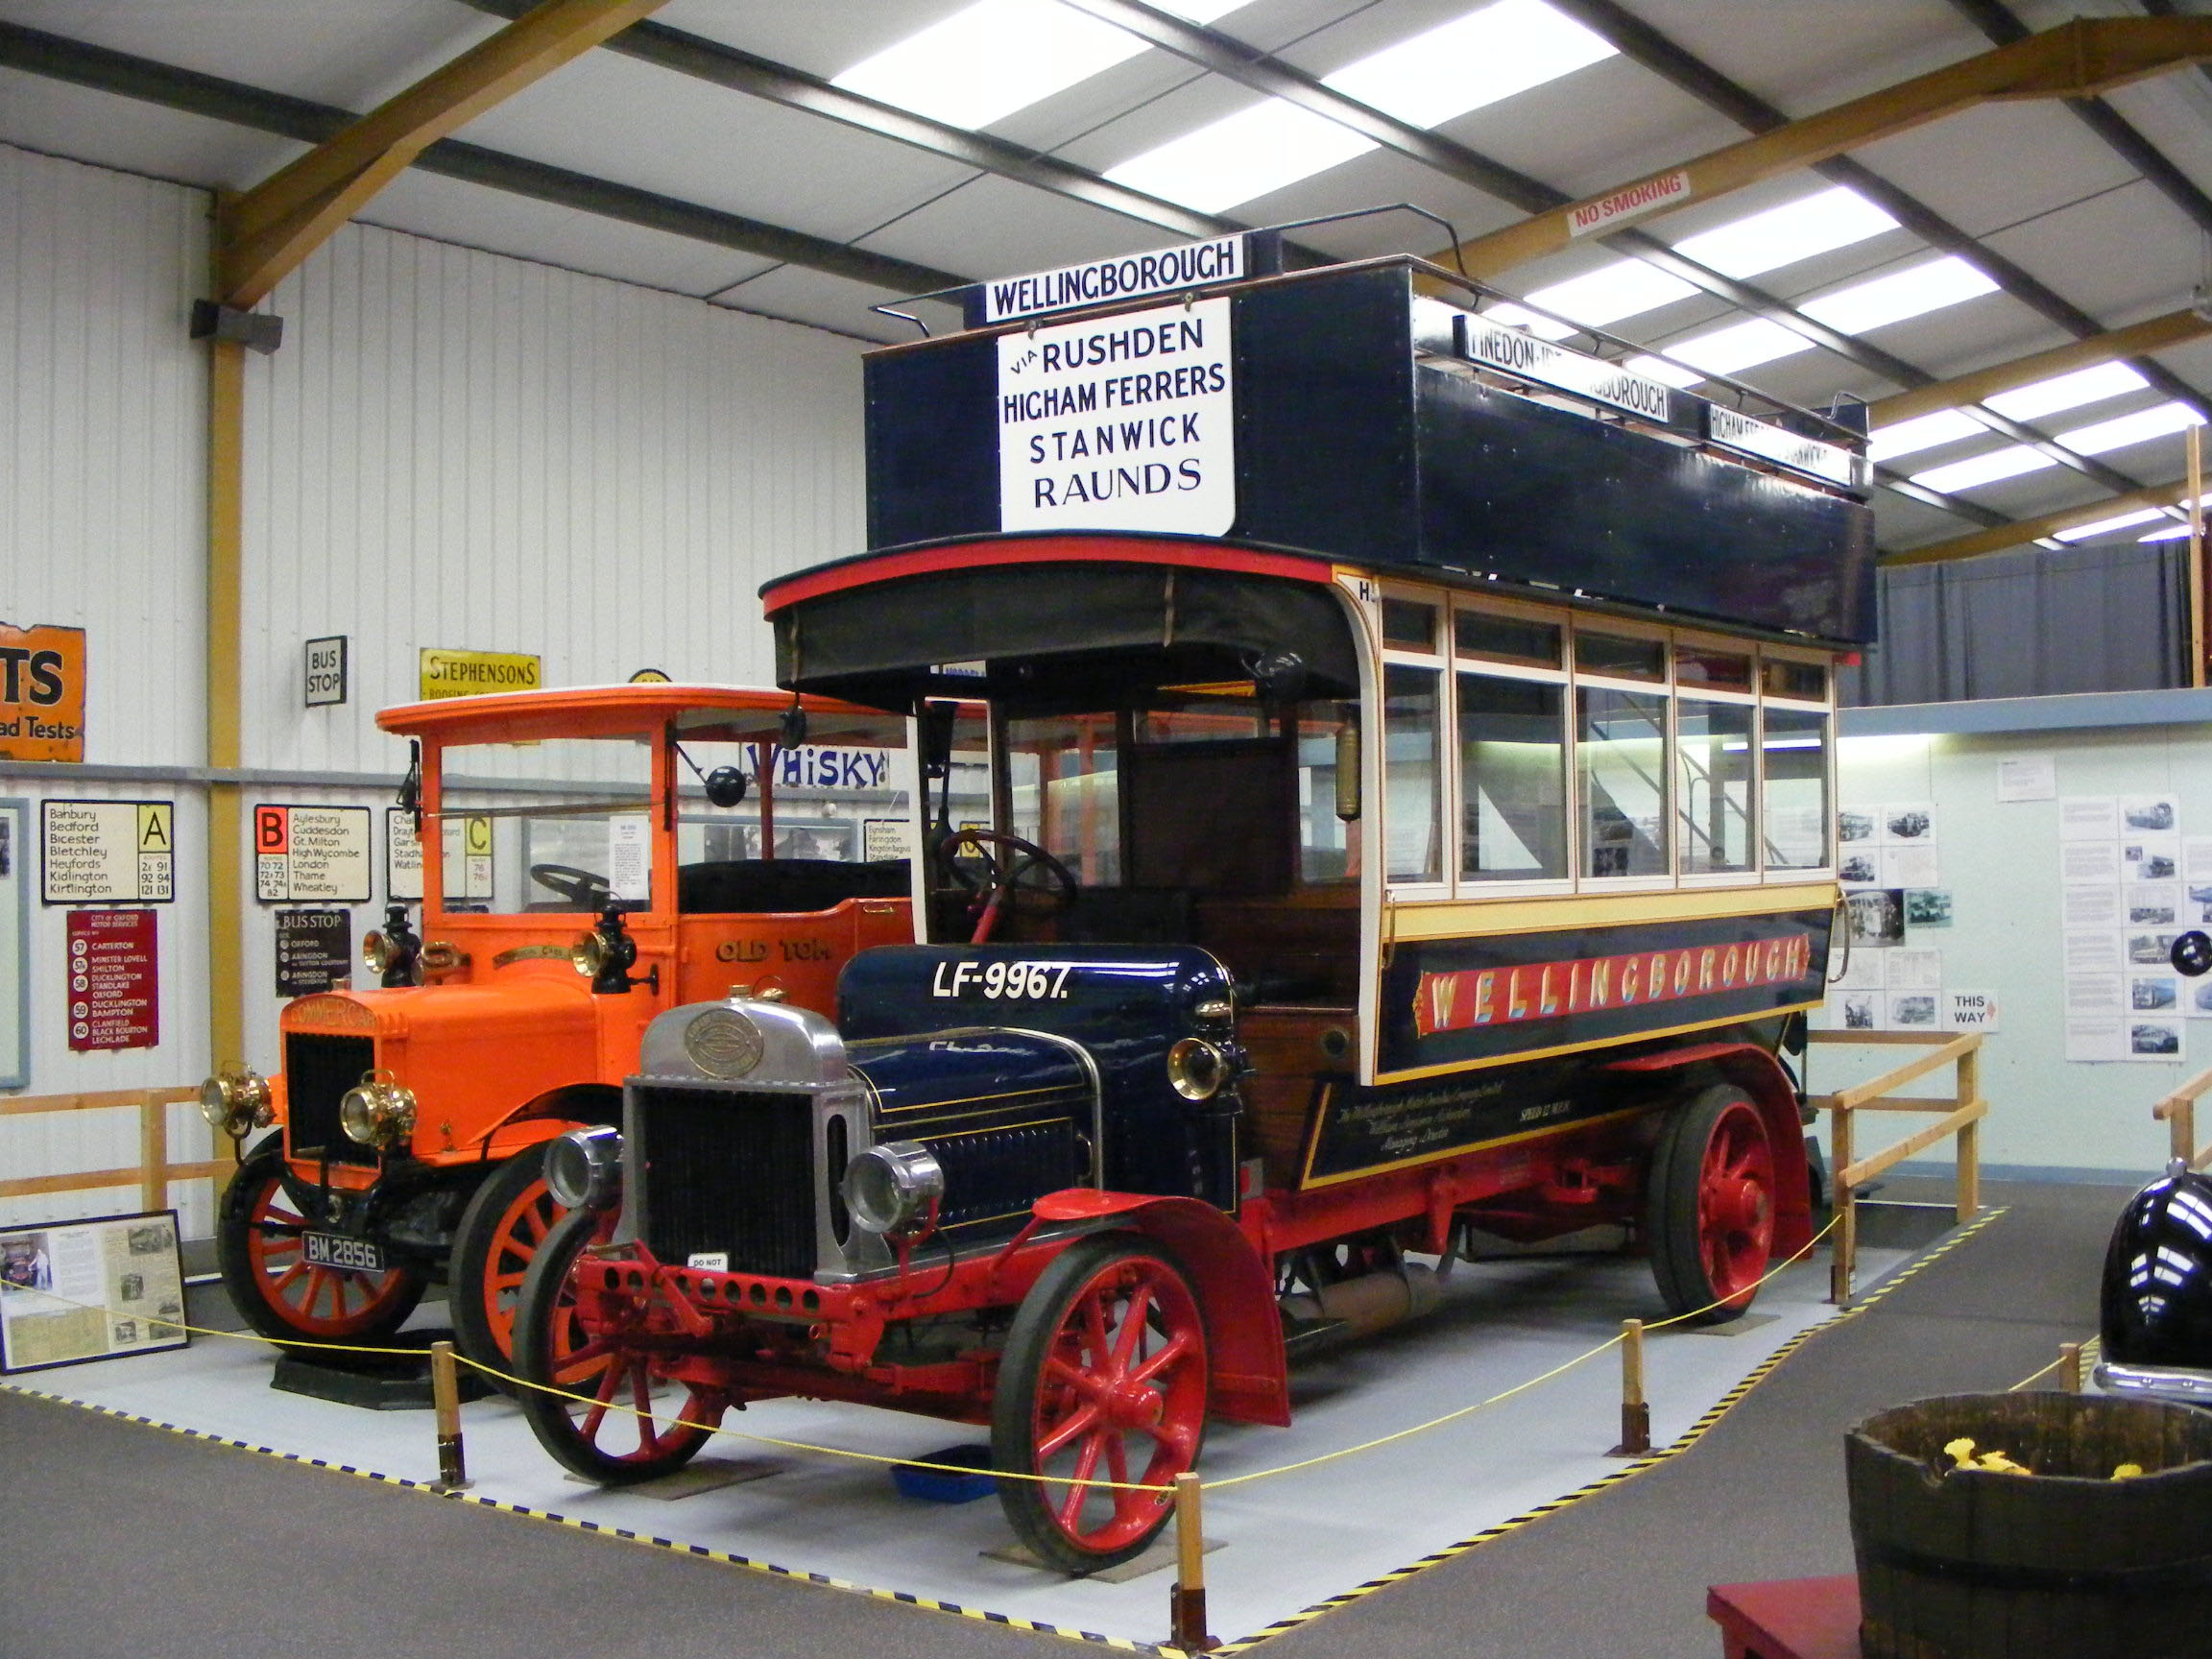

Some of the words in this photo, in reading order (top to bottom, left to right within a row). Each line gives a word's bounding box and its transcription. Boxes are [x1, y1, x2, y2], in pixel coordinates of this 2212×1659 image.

[1575, 204, 1599, 228] NO
[1602, 175, 1682, 217] SMOKING
[994, 240, 1235, 317] WELLINGBOROUGH
[1010, 349, 1038, 374] VIA
[1043, 319, 1203, 373] RUSHDEN
[1003, 382, 1097, 423] HIGHAM
[1105, 362, 1226, 408] FERRERS
[1029, 412, 1200, 464] STANWICK
[1034, 458, 1201, 508] RAUNDS
[1359, 581, 1369, 602] H
[312, 650, 336, 669] BUS
[0, 646, 63, 706] TS
[429, 656, 536, 685] STEPHENSONS
[308, 673, 341, 692] STOP
[0, 716, 20, 737] ad
[25, 716, 74, 739] Tests
[50, 808, 96, 822] Banbury
[293, 814, 340, 827] Aylesbury
[50, 821, 99, 831] Bedford
[143, 811, 166, 845] A
[261, 812, 283, 847] B
[293, 826, 349, 835] Cuddesdon
[50, 833, 100, 844] Bicester
[469, 817, 487, 850] C
[308, 837, 340, 846] Milton
[869, 835, 902, 845] Faringdon
[50, 847, 107, 859] Bletchley
[293, 849, 313, 859] High
[314, 849, 360, 860] Wycombe
[50, 859, 101, 872] Heyfords
[157, 861, 167, 871] 91
[260, 861, 271, 870] 70
[272, 861, 283, 870] 72
[293, 860, 329, 869] London
[50, 871, 108, 883] Kidlington
[141, 873, 153, 882] 92
[157, 873, 169, 882] 94
[294, 871, 325, 880] Thame
[50, 884, 112, 897] Kirtlington
[141, 885, 153, 895] 121
[157, 885, 168, 895] 131
[294, 883, 337, 895] Wheatley
[283, 916, 308, 929] BUS
[309, 915, 341, 928] STOP
[75, 943, 84, 951] 57
[91, 942, 134, 950] CARTERTON
[92, 965, 125, 974] SHILTON
[75, 978, 85, 989] 58
[91, 973, 142, 981] DUCKLINGTON
[91, 981, 130, 990] STANDLAKE
[1431, 937, 1801, 1029] WELLINGBOROUGH
[92, 990, 123, 998] OXFORD
[75, 1004, 86, 1015] 59
[92, 998, 148, 1008] DUCKLINGTON
[1955, 996, 1984, 1007] THIS
[92, 1008, 133, 1018] BAMPTON
[1955, 1012, 1984, 1023] WAY
[75, 1025, 87, 1035] 60
[92, 1028, 113, 1037] BLACK
[91, 1035, 130, 1045] LECHLADE
[308, 1236, 329, 1262] BM
[332, 1238, 377, 1267] 2856
